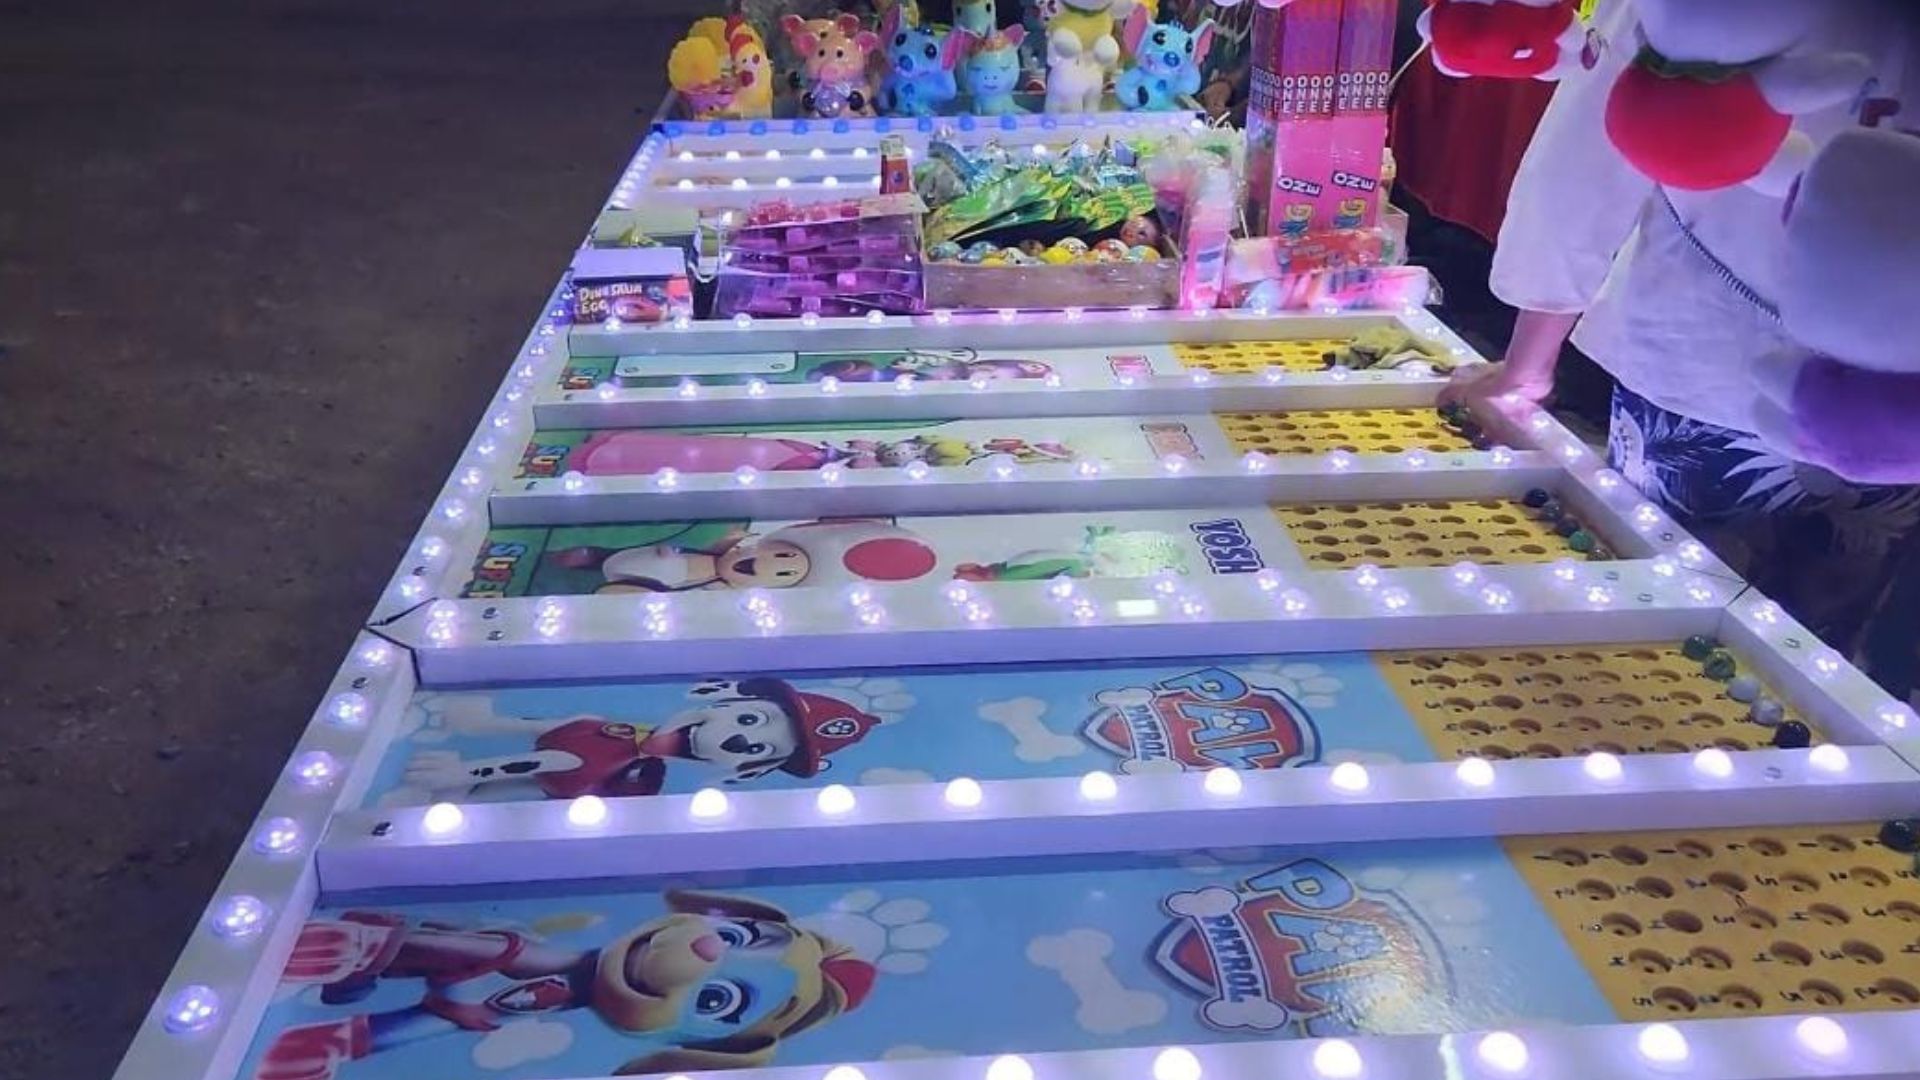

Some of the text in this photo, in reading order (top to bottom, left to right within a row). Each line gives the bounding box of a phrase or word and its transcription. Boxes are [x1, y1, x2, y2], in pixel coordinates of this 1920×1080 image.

[1283, 76, 1294, 113] ONE
[1296, 75, 1307, 112] ONE
[1309, 75, 1321, 112] ONE
[1322, 75, 1334, 112] ONE
[1338, 73, 1350, 109] ONE
[1351, 72, 1363, 109] ONE
[1364, 72, 1377, 109] ONE
[1377, 72, 1389, 108] ONE
[1277, 176, 1321, 196] ONE
[1333, 171, 1375, 190] ONE
[1127, 704, 1167, 761] PATROL
[1754, 874, 1779, 886] 5
[1789, 911, 1810, 921] 4
[1862, 907, 1887, 917] 3
[1201, 915, 1262, 1003] PATROL
[1752, 951, 1773, 962] 4
[1819, 949, 1845, 961] 3
[1779, 991, 1804, 1002] 5
